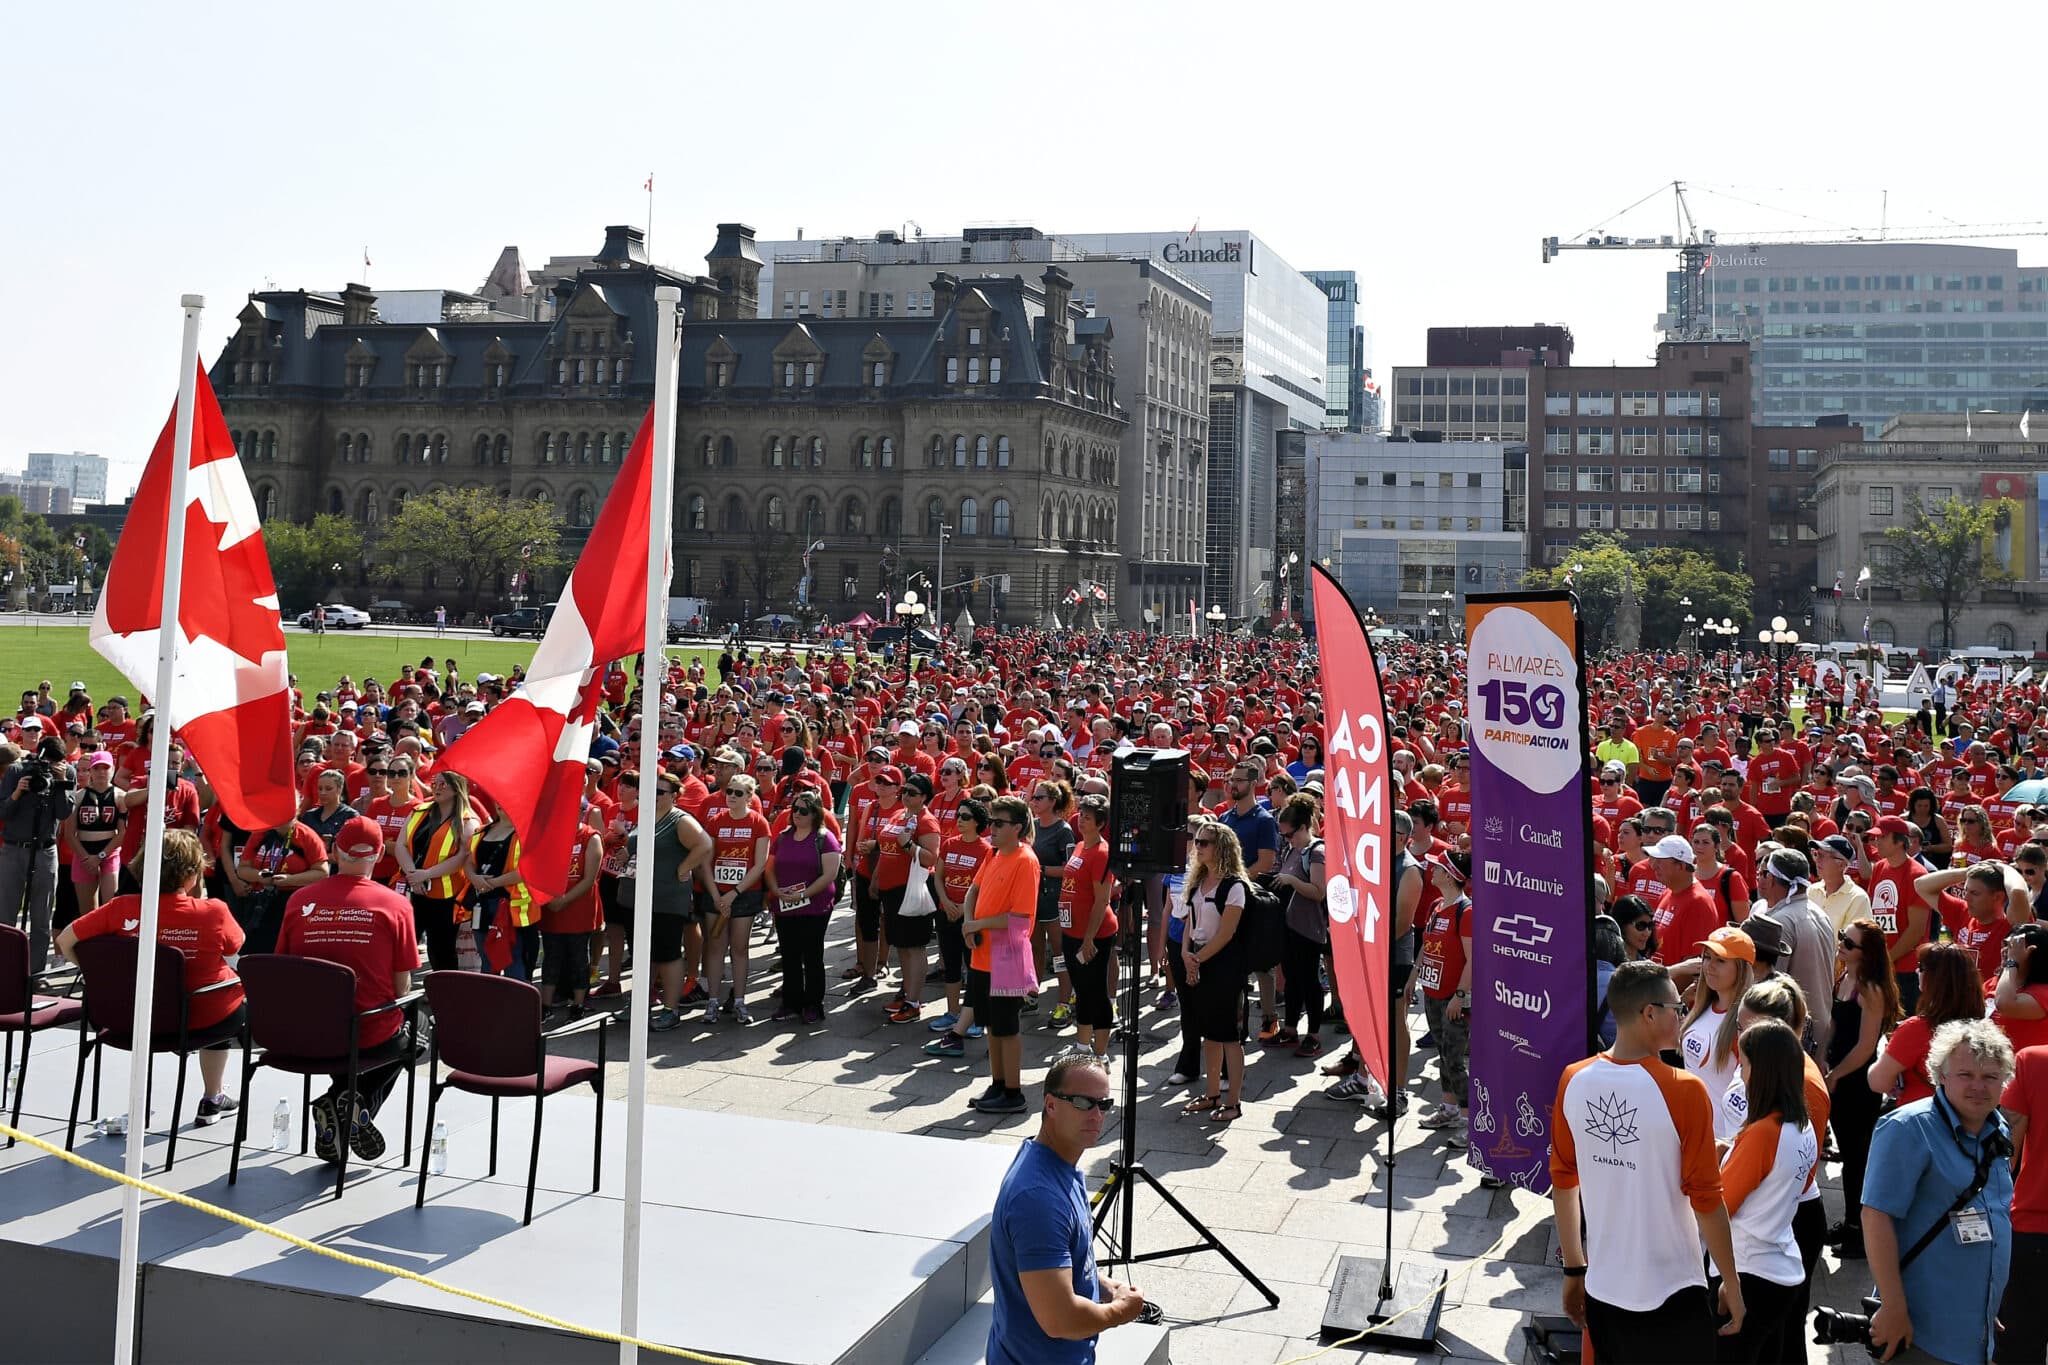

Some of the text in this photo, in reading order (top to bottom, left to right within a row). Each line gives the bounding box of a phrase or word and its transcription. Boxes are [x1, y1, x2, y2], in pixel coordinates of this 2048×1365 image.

[1163, 243, 1241, 263] Canada
[1712, 253, 1768, 267] Deloitte
[1488, 652, 1564, 677] PALMARÈS
[1478, 679, 1565, 730] 150
[1484, 729, 1569, 751] PARTICIPACTION
[1520, 824, 1562, 849] Canada
[717, 868, 744, 881] 1326
[1503, 869, 1564, 897] Manuvie
[1493, 943, 1553, 965] CHEVROLET
[1592, 1154, 1625, 1167] CANADA
